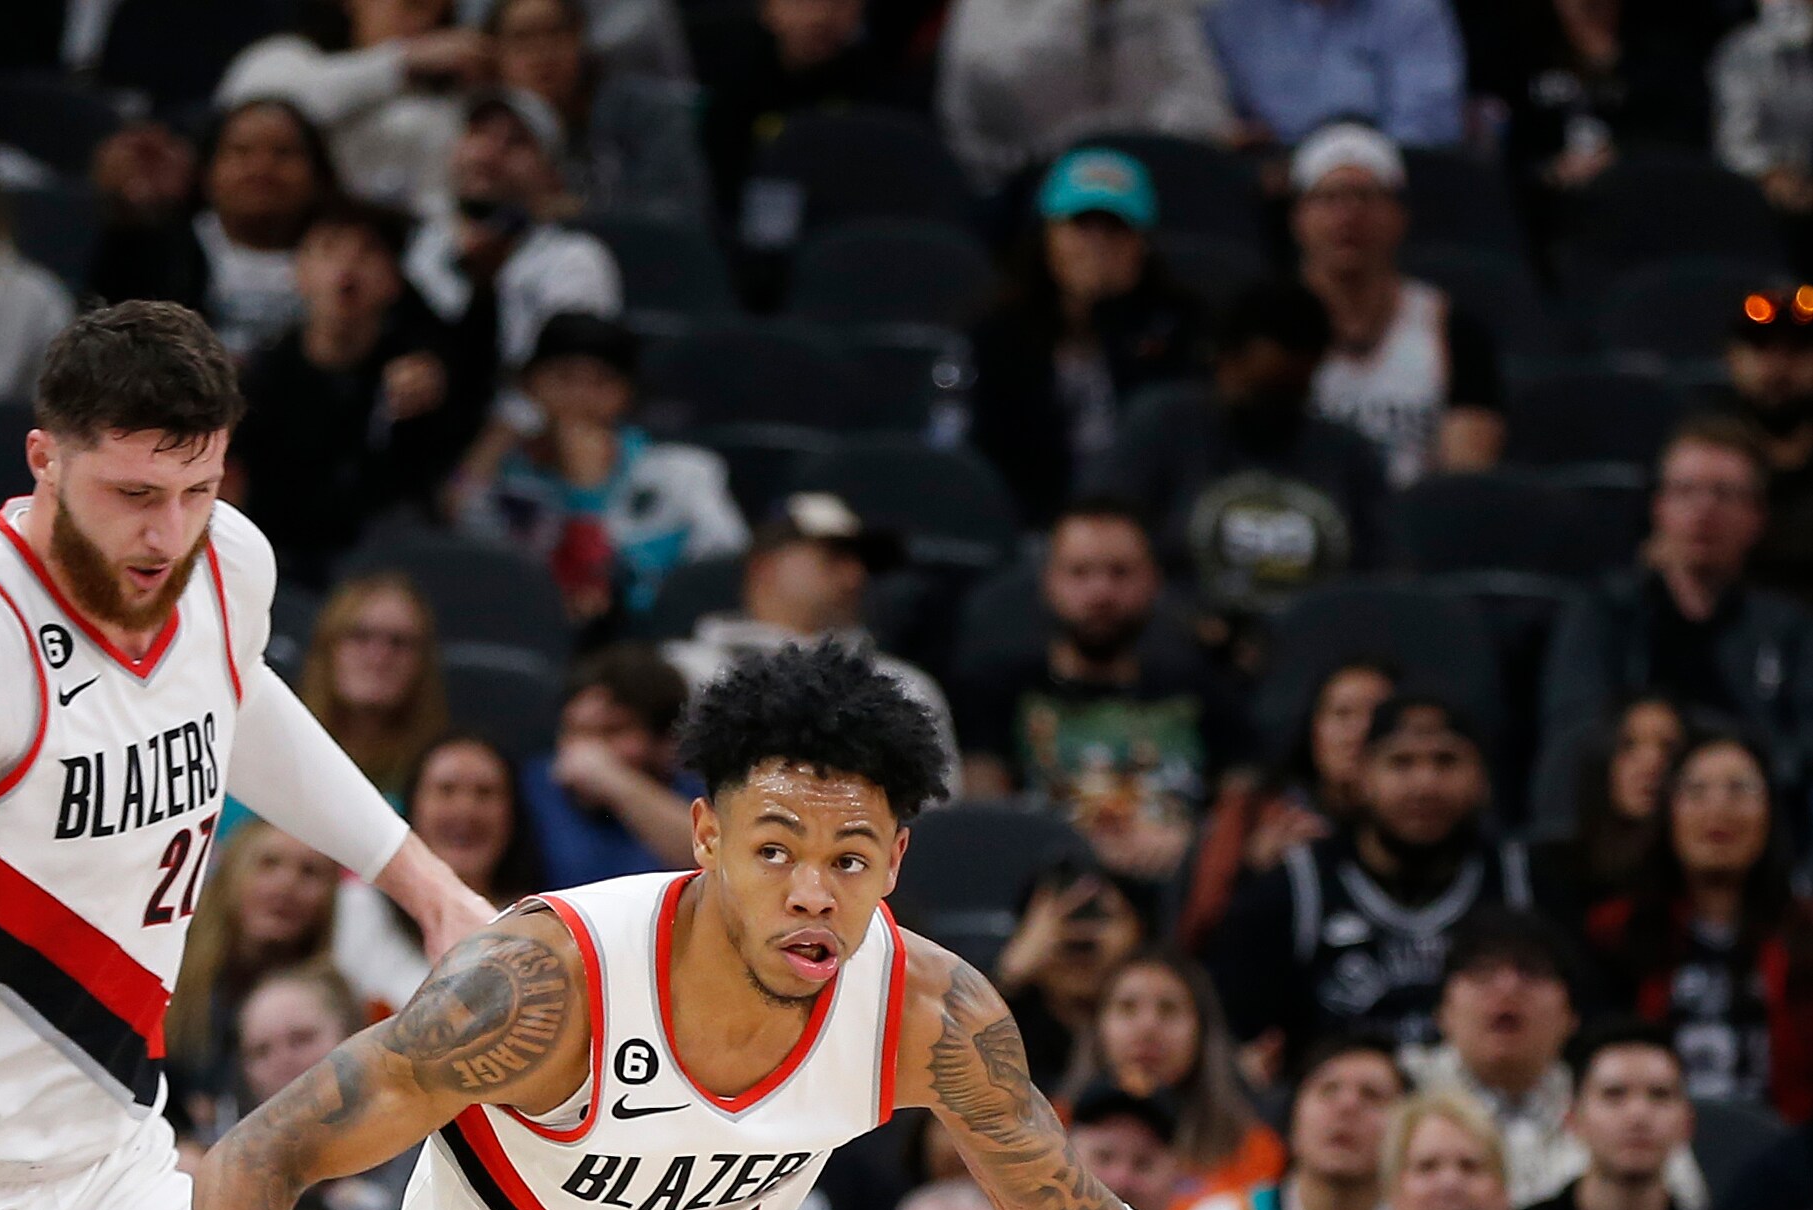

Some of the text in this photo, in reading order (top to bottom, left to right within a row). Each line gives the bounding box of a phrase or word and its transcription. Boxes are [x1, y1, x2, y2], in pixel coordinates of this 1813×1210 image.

[41, 629, 66, 664] 6
[54, 711, 219, 840] BLAZERS
[622, 1045, 650, 1080] 6
